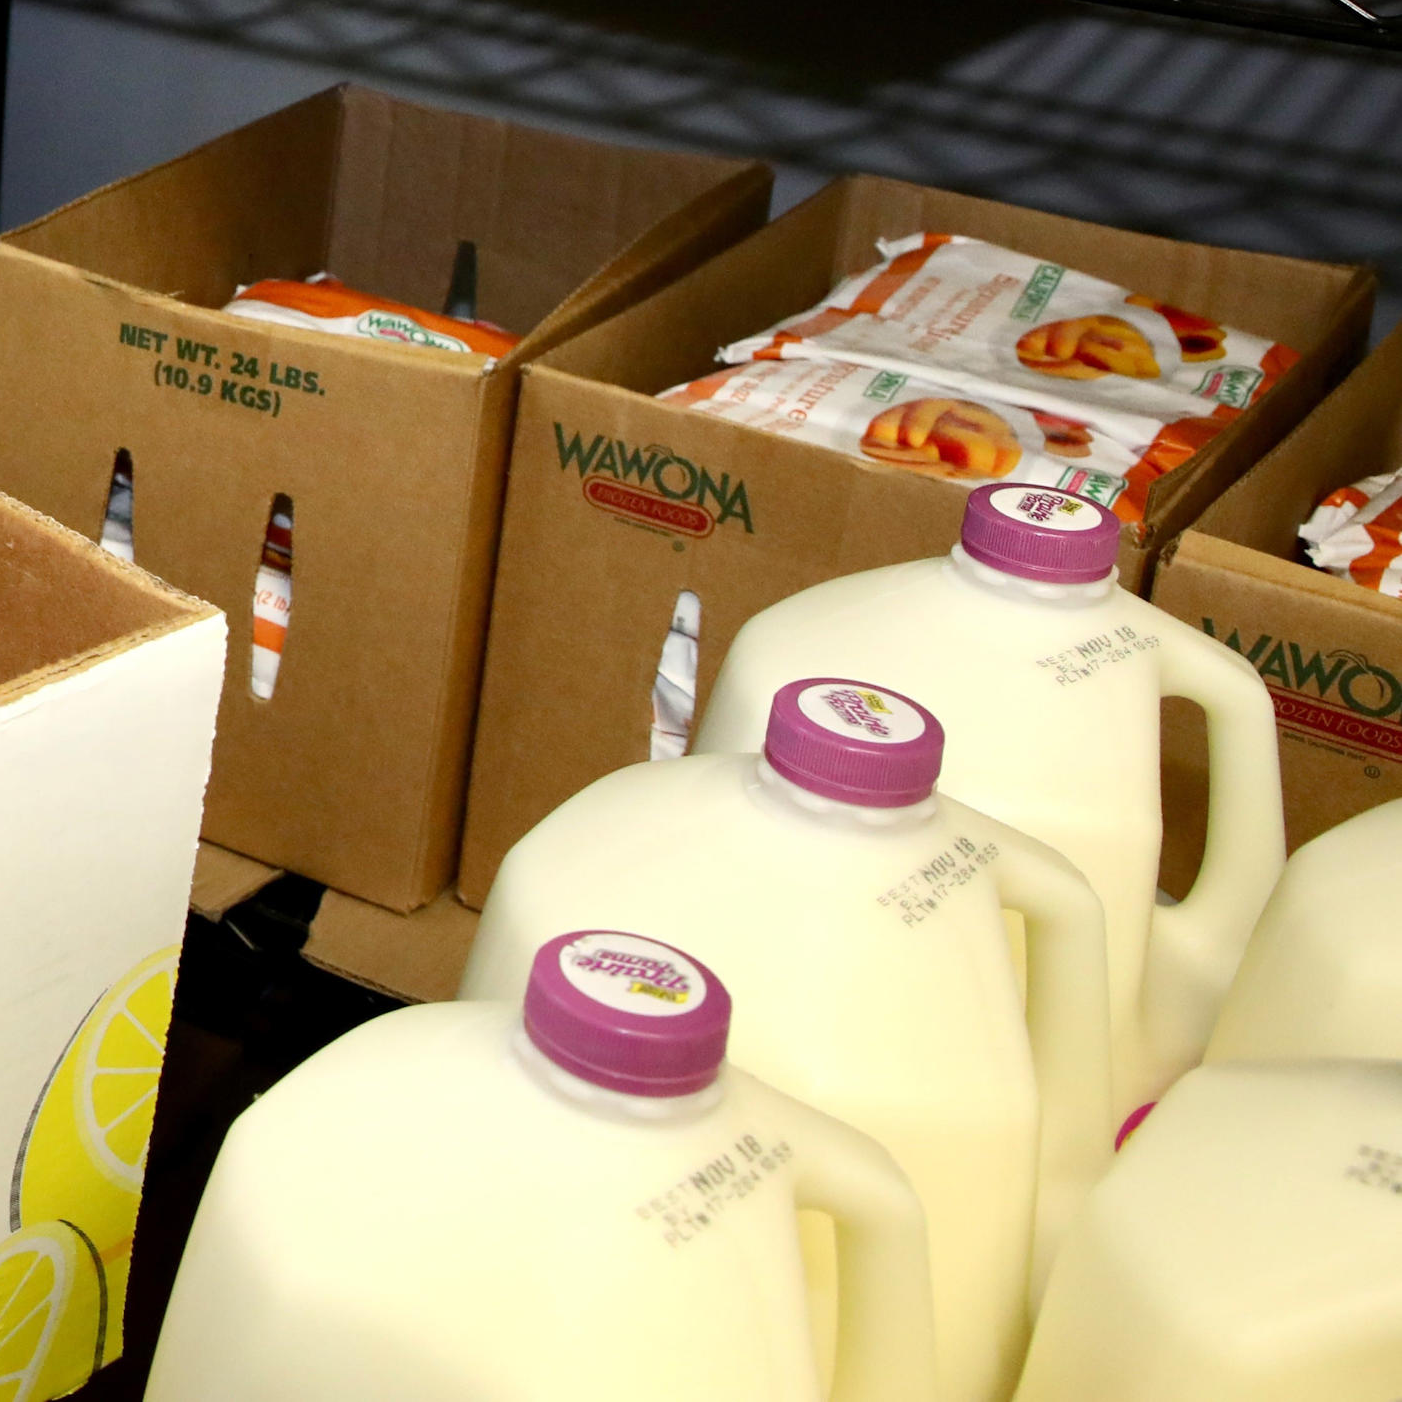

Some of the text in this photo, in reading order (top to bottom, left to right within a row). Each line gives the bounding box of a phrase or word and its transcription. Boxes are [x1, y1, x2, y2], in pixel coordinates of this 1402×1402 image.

[119, 322, 326, 397] NET WT. 24 LBS.
[153, 360, 282, 418] (10.9 KGS)
[553, 421, 754, 534] WAWONA
[596, 485, 699, 527] FROZEN FOODS
[1075, 633, 1113, 660] NOV
[1114, 624, 1137, 644] 18
[920, 850, 957, 885] NOV
[952, 835, 977, 859] 18
[688, 1133, 763, 1196] NOV 18
